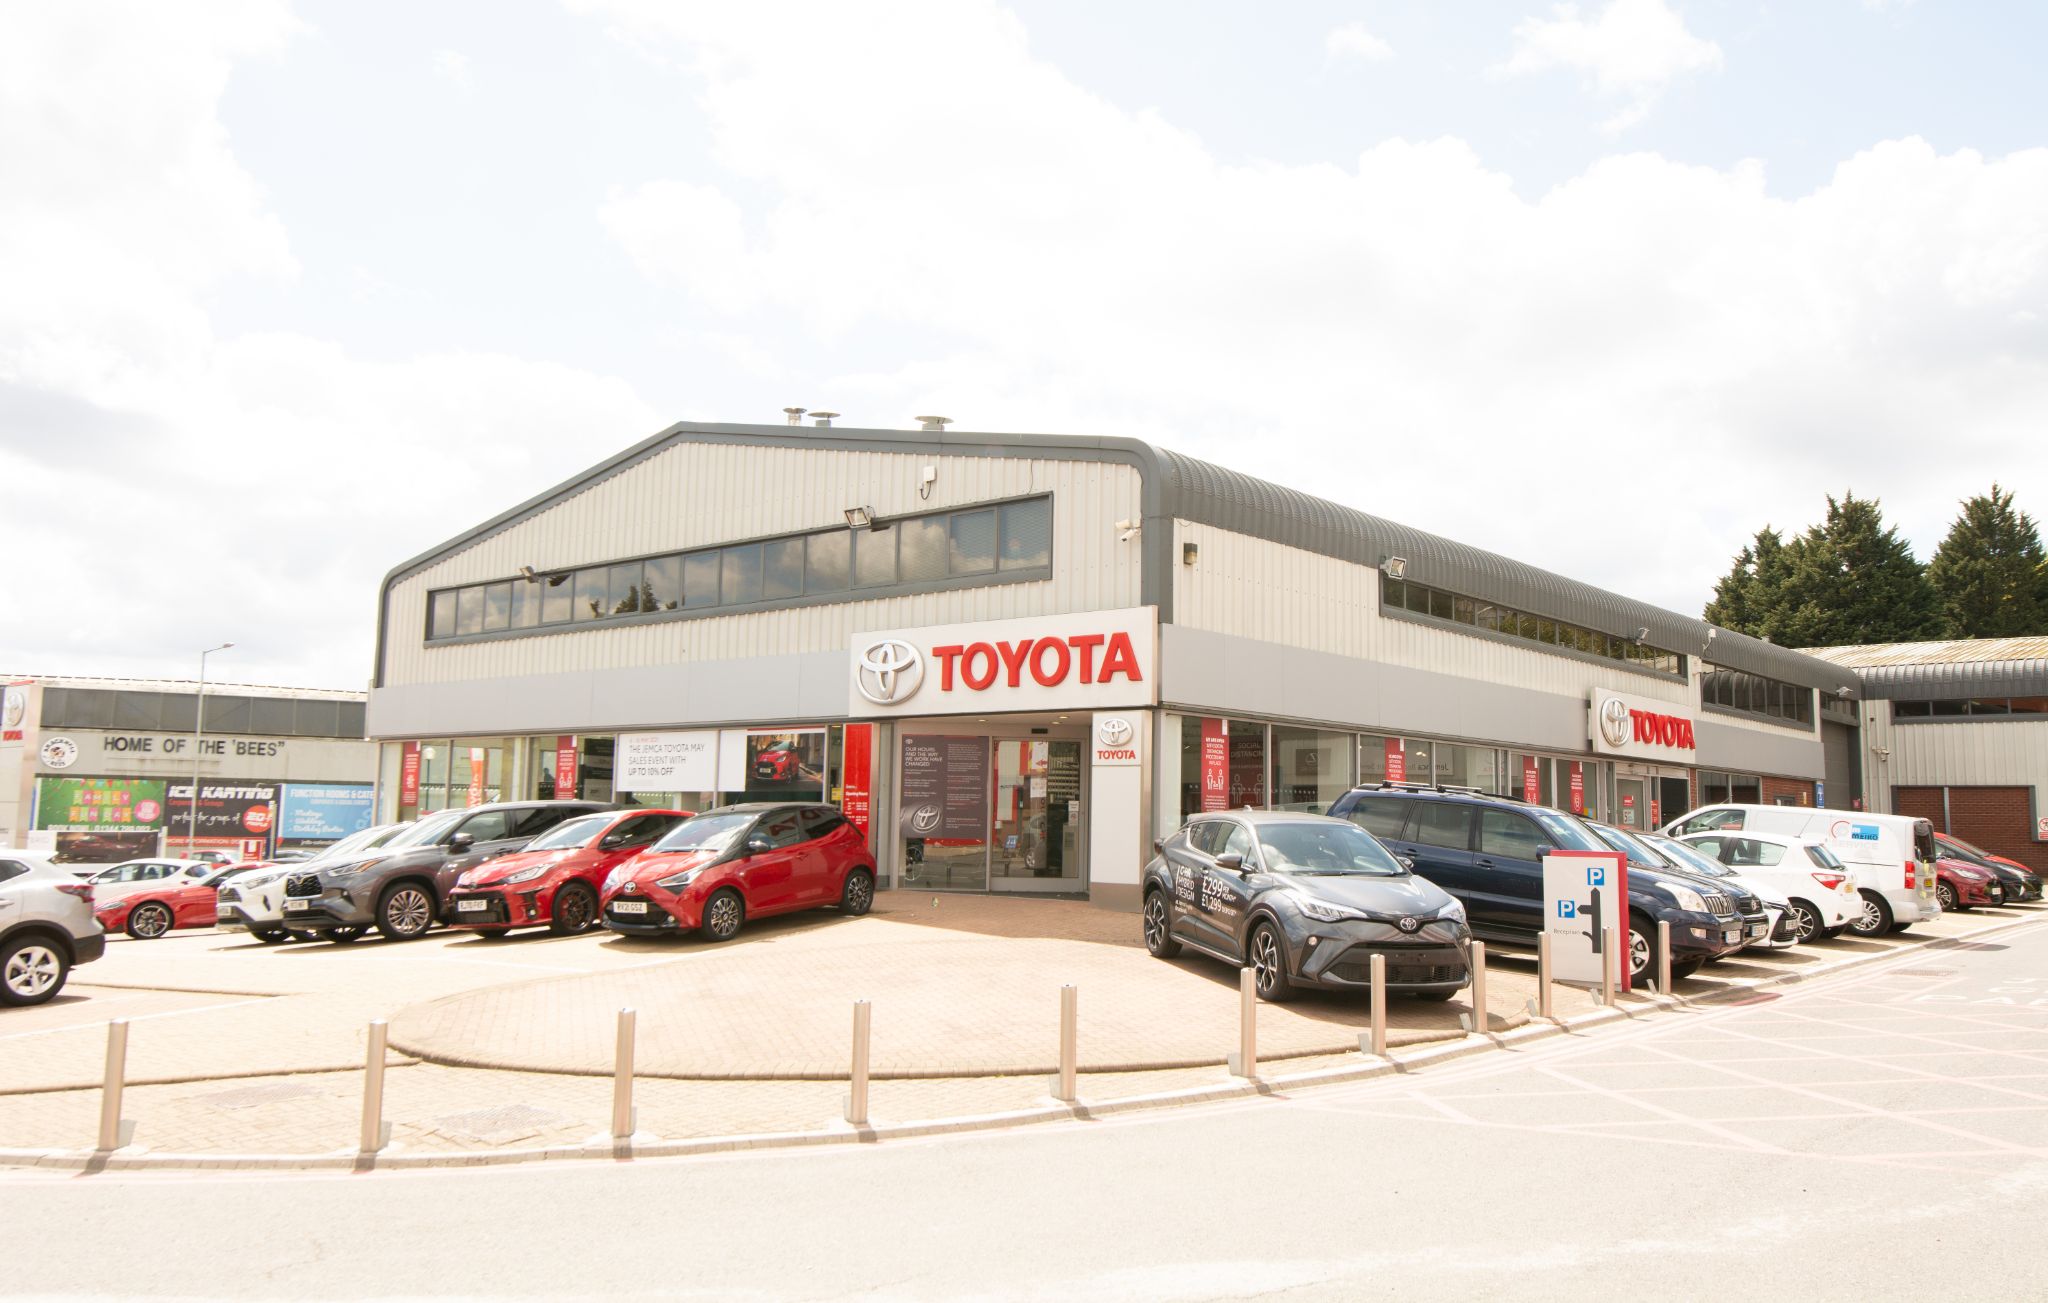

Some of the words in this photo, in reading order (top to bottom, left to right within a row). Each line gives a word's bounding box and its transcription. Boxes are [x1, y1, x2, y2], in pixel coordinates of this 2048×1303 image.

[932, 632, 1143, 691] TOYOTA
[1629, 709, 1695, 750] TOYOTA
[103, 737, 153, 752] HOME
[163, 738, 187, 753] OF
[195, 740, 226, 754] THE
[629, 744, 640, 753] THE
[664, 744, 689, 752] TOYOTA
[690, 744, 704, 752] MAY
[628, 756, 647, 764] SALES
[648, 756, 668, 764] EVENT
[669, 756, 686, 764] WITH
[1097, 750, 1136, 760] TOYOTA
[628, 768, 638, 776] UP
[638, 768, 646, 776] TO
[201, 786, 274, 799] KARTING
[1178, 876, 1194, 890] HYBRID
[1202, 876, 1223, 897] £299
[1178, 887, 1195, 901] DESIGN
[1202, 894, 1222, 912] £1,299
